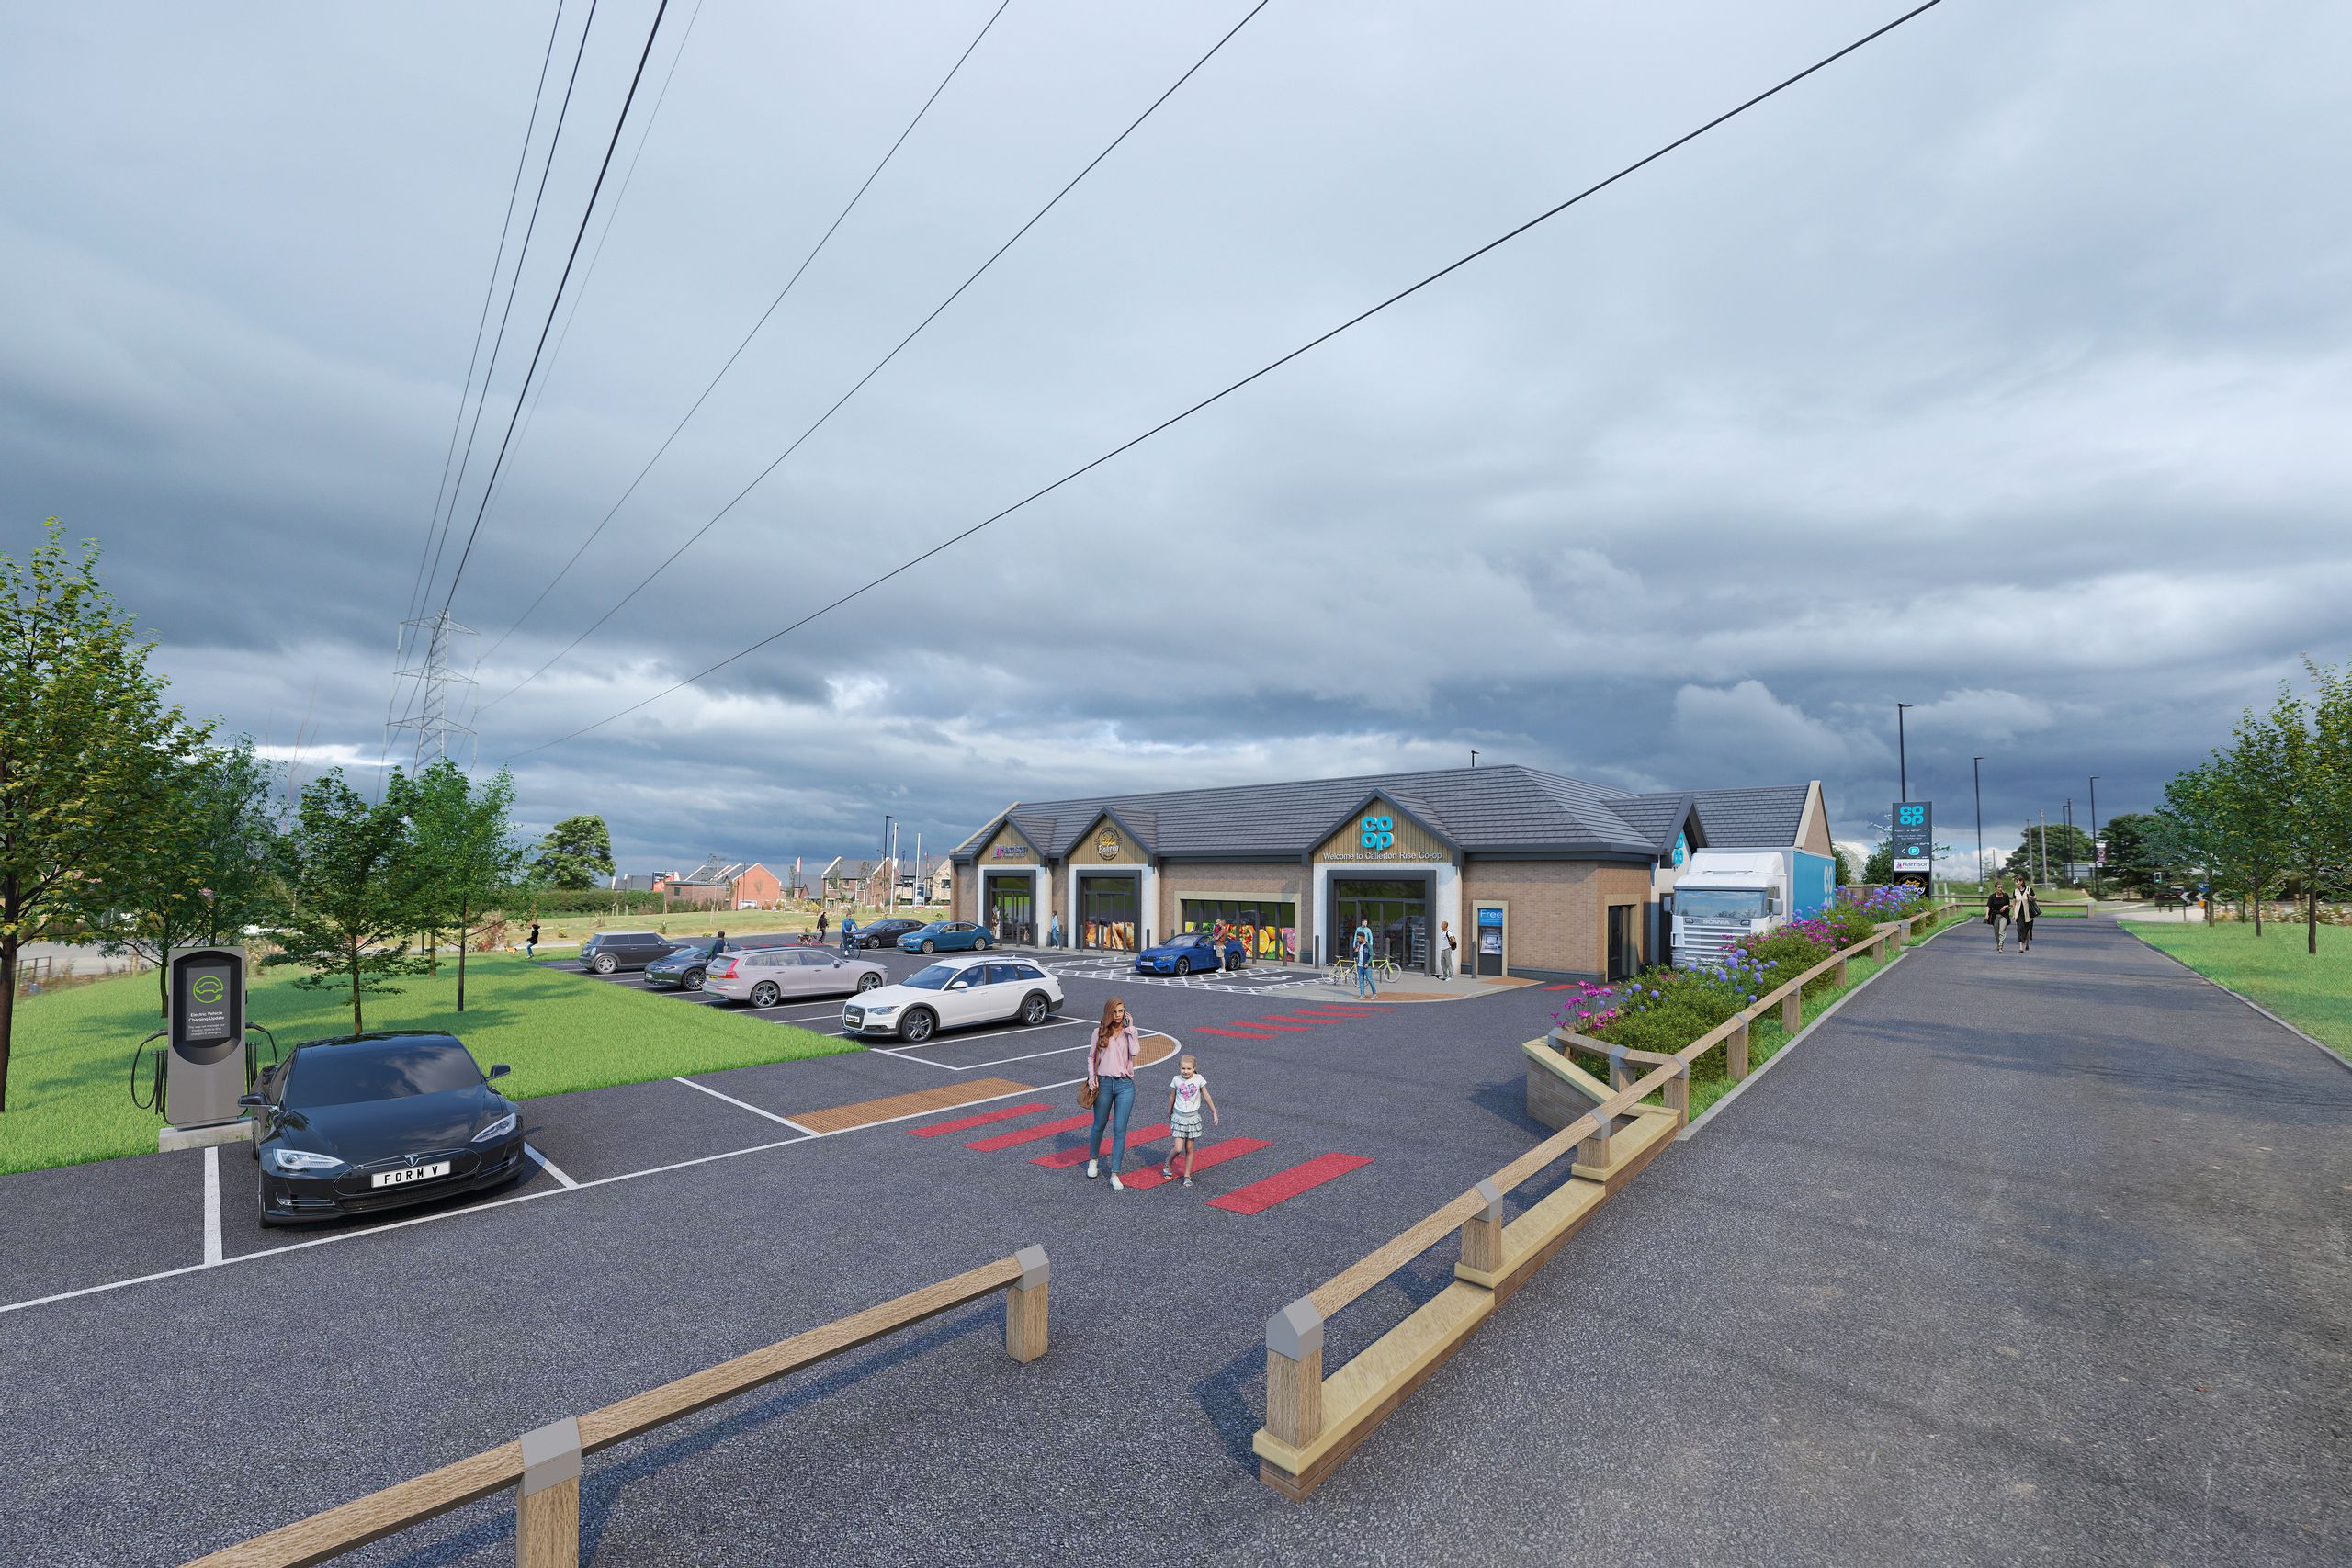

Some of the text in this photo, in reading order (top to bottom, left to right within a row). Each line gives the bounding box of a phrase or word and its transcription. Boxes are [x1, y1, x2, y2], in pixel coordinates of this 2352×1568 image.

[1098, 844, 1119, 854] Bakery
[1418, 852, 1442, 861] Co-op
[1480, 909, 1502, 918] Free
[384, 1166, 438, 1184] FORM V
